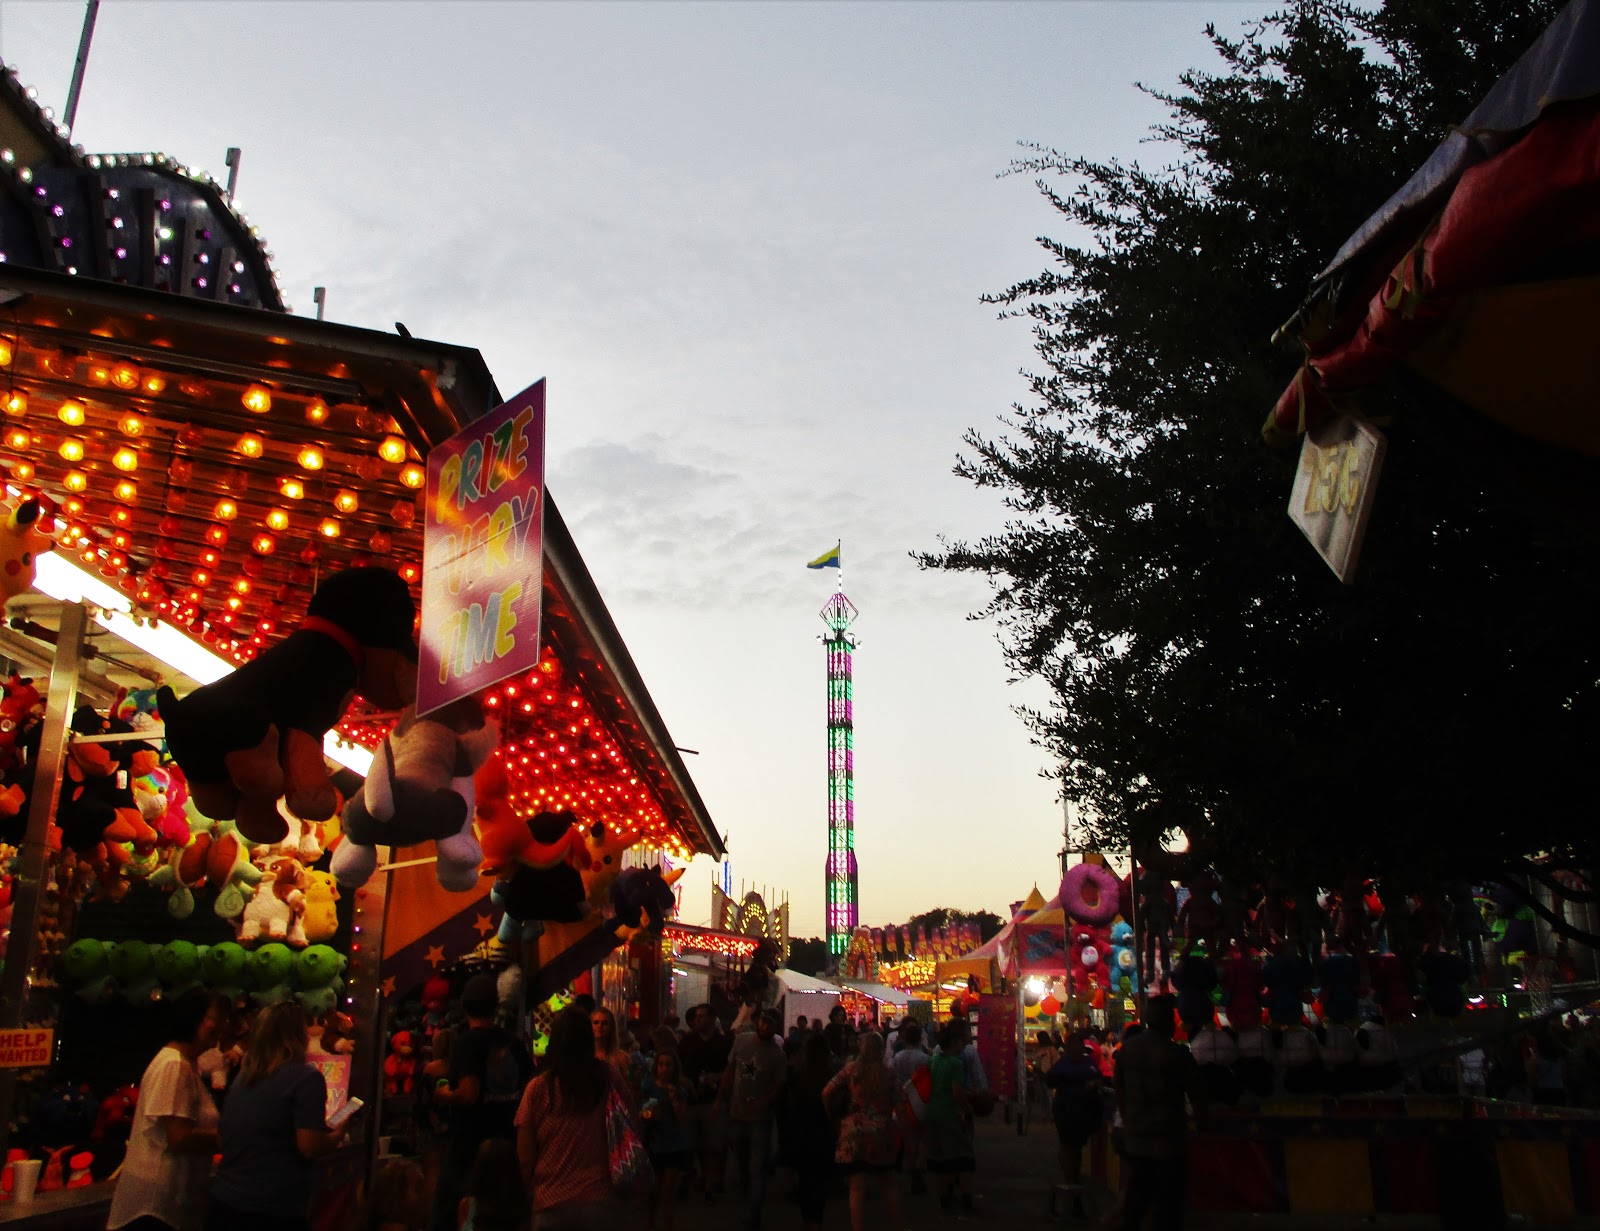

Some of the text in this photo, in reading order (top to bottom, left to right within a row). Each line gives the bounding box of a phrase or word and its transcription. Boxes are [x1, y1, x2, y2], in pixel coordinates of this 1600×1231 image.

[435, 404, 534, 524] PRIZE
[431, 485, 538, 602] VERY
[438, 580, 523, 685] TIME
[899, 966, 936, 979] BURGE
[0, 1033, 47, 1048] HELP
